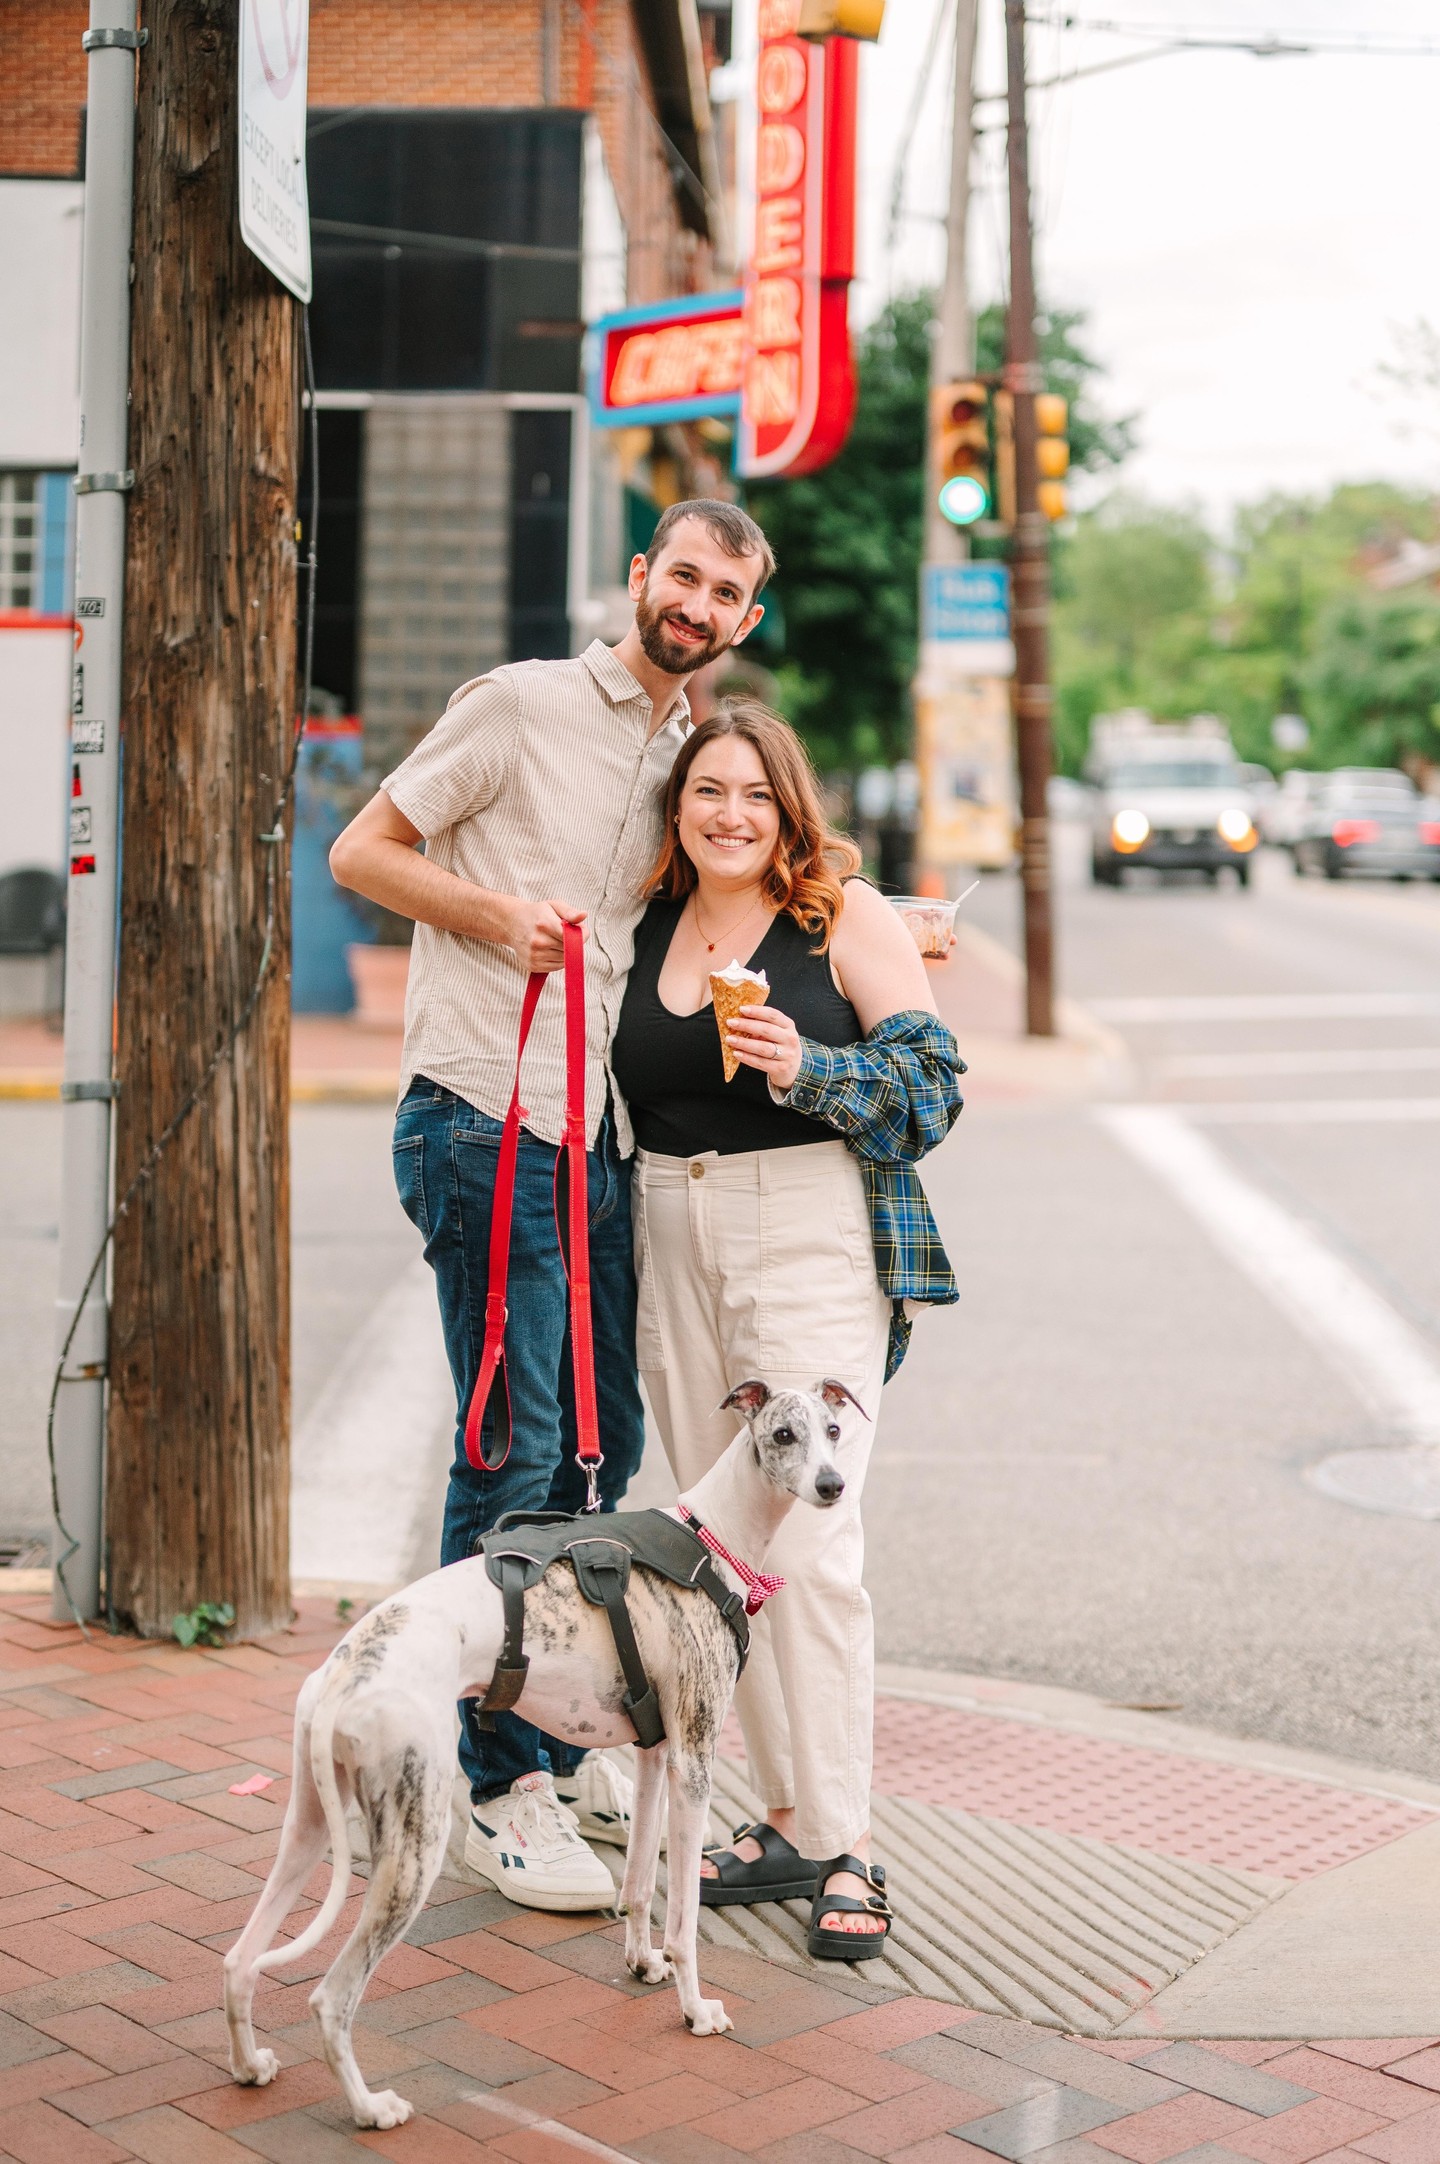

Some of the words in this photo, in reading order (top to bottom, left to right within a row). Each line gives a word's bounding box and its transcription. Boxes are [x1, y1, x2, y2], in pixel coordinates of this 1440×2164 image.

[244, 112, 274, 177] EXCEPT
[276, 151, 304, 208] LOCAL
[251, 176, 298, 253] DELIVERIES
